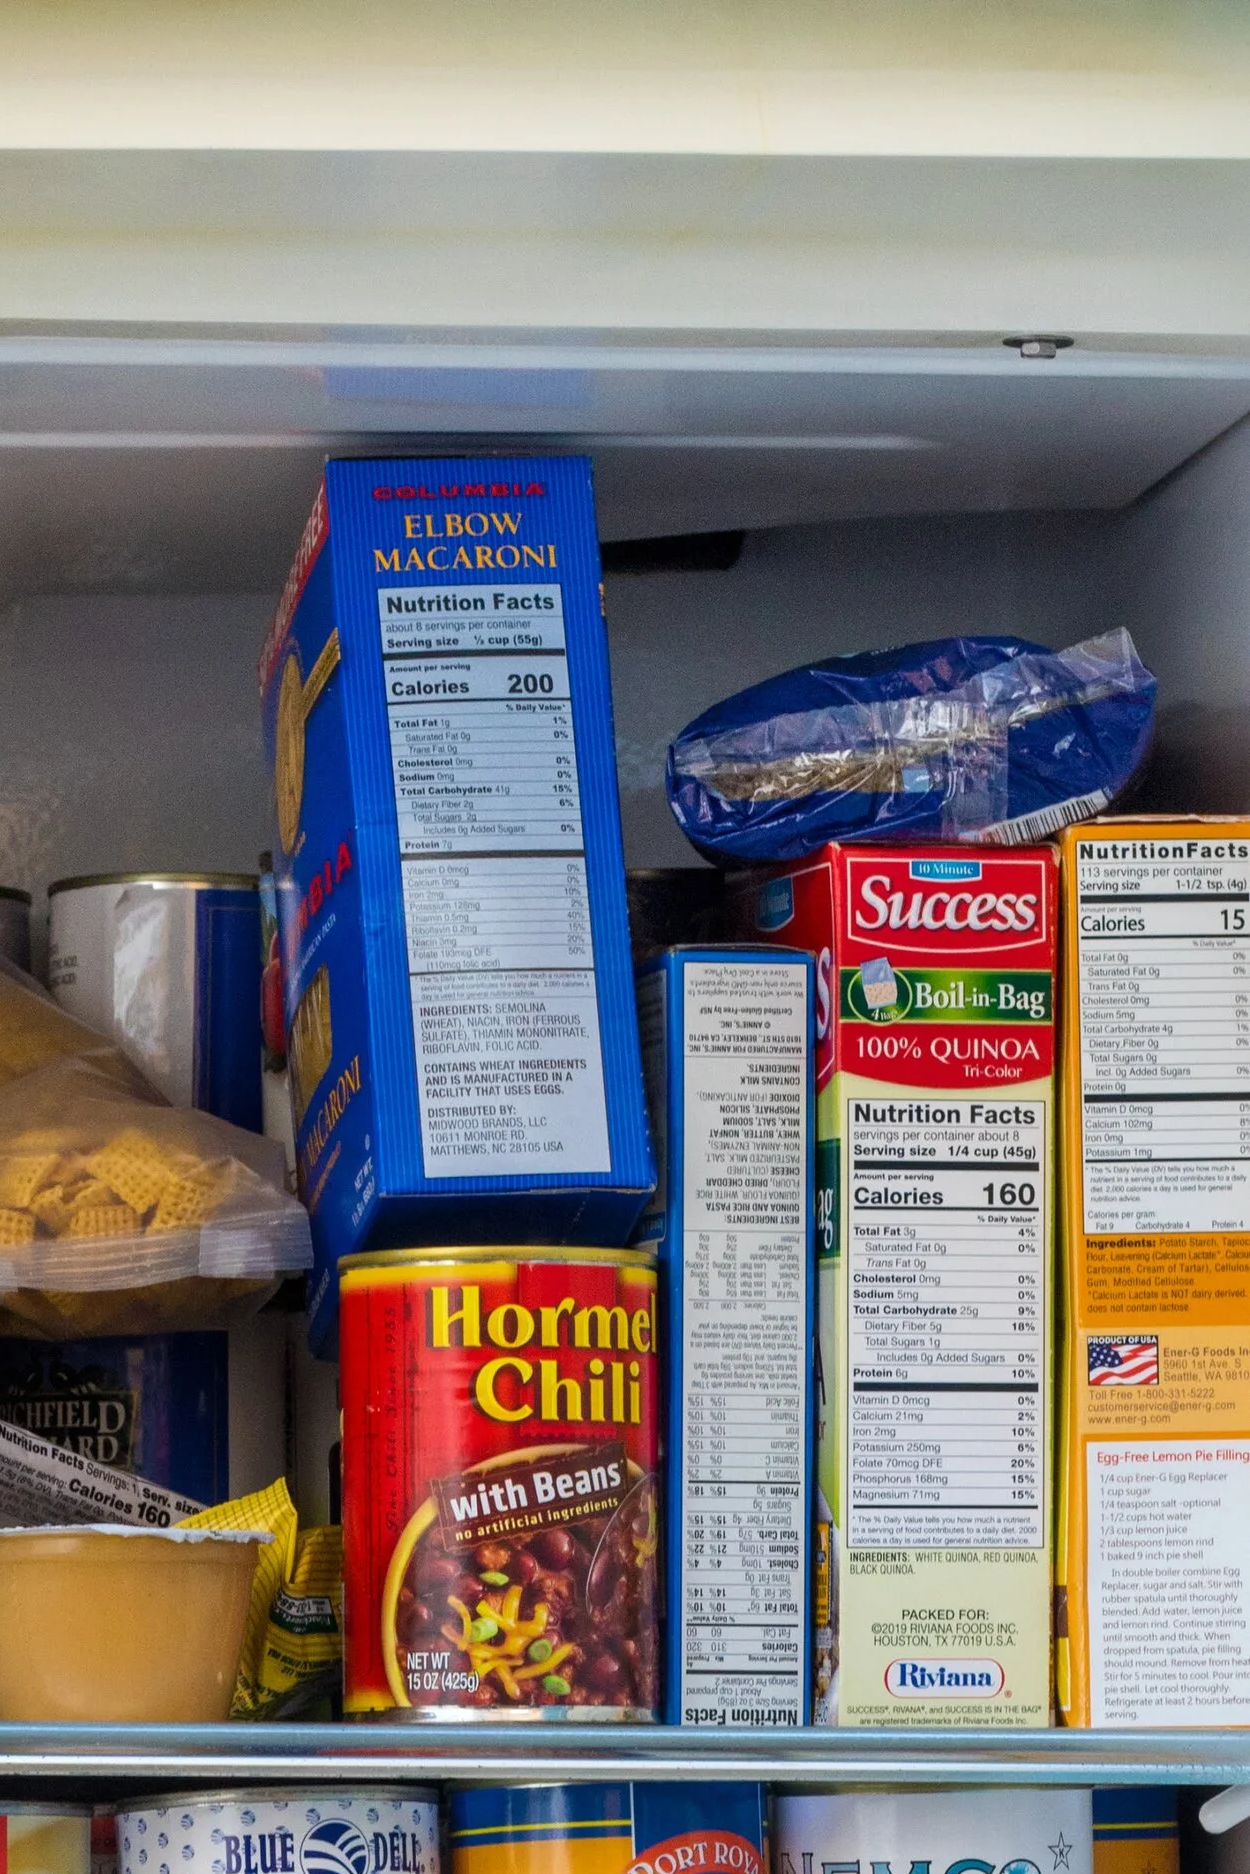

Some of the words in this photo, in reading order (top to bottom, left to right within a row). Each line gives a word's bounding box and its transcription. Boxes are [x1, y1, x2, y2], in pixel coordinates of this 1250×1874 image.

[372, 482, 544, 499] COLUMBIA
[405, 513, 522, 539] ELBOW
[373, 544, 557, 572] MACARONI
[387, 596, 485, 613] Nutrition
[493, 593, 554, 610] Facts
[392, 680, 469, 696] Calories
[508, 674, 553, 693] 200
[918, 864, 929, 874] 10
[932, 864, 973, 874] Minute
[856, 875, 1036, 931] Success
[1081, 916, 1145, 932] Calories
[1220, 909, 1245, 930] 15
[915, 982, 1045, 1019] Boil-in-Bag
[857, 1036, 921, 1058] 100%
[931, 1037, 1039, 1064] QUINOA
[963, 1064, 1022, 1079] Tri-Color
[854, 1104, 961, 1123] Nutrition
[971, 1105, 1035, 1124] Facts
[854, 1145, 905, 1158] Serving
[909, 1145, 936, 1156] size
[948, 1145, 969, 1157] 1/4
[974, 1147, 998, 1159] cup
[1003, 1146, 1036, 1159] (45g)
[854, 1188, 943, 1204] Calories
[983, 1182, 1035, 1205] 160
[431, 1284, 656, 1353] Hormel
[475, 1356, 641, 1424] Chili
[51, 1447, 84, 1470] Facts
[1097, 1450, 1148, 1465] Egg-Free
[1150, 1450, 1192, 1463] Lemon
[1195, 1450, 1213, 1461] Pie
[1216, 1449, 1249, 1464] Filling
[69, 1478, 133, 1513] Calories
[137, 1502, 170, 1528] 160
[450, 1478, 525, 1522] with
[536, 1460, 621, 1501] Beans
[455, 1528, 473, 1541] no
[477, 1513, 543, 1537] artificial
[548, 1496, 618, 1522] ingredients
[896, 1662, 994, 1688] Riviana
[225, 1833, 294, 1874] BLUE
[375, 1833, 419, 1874] DELL
